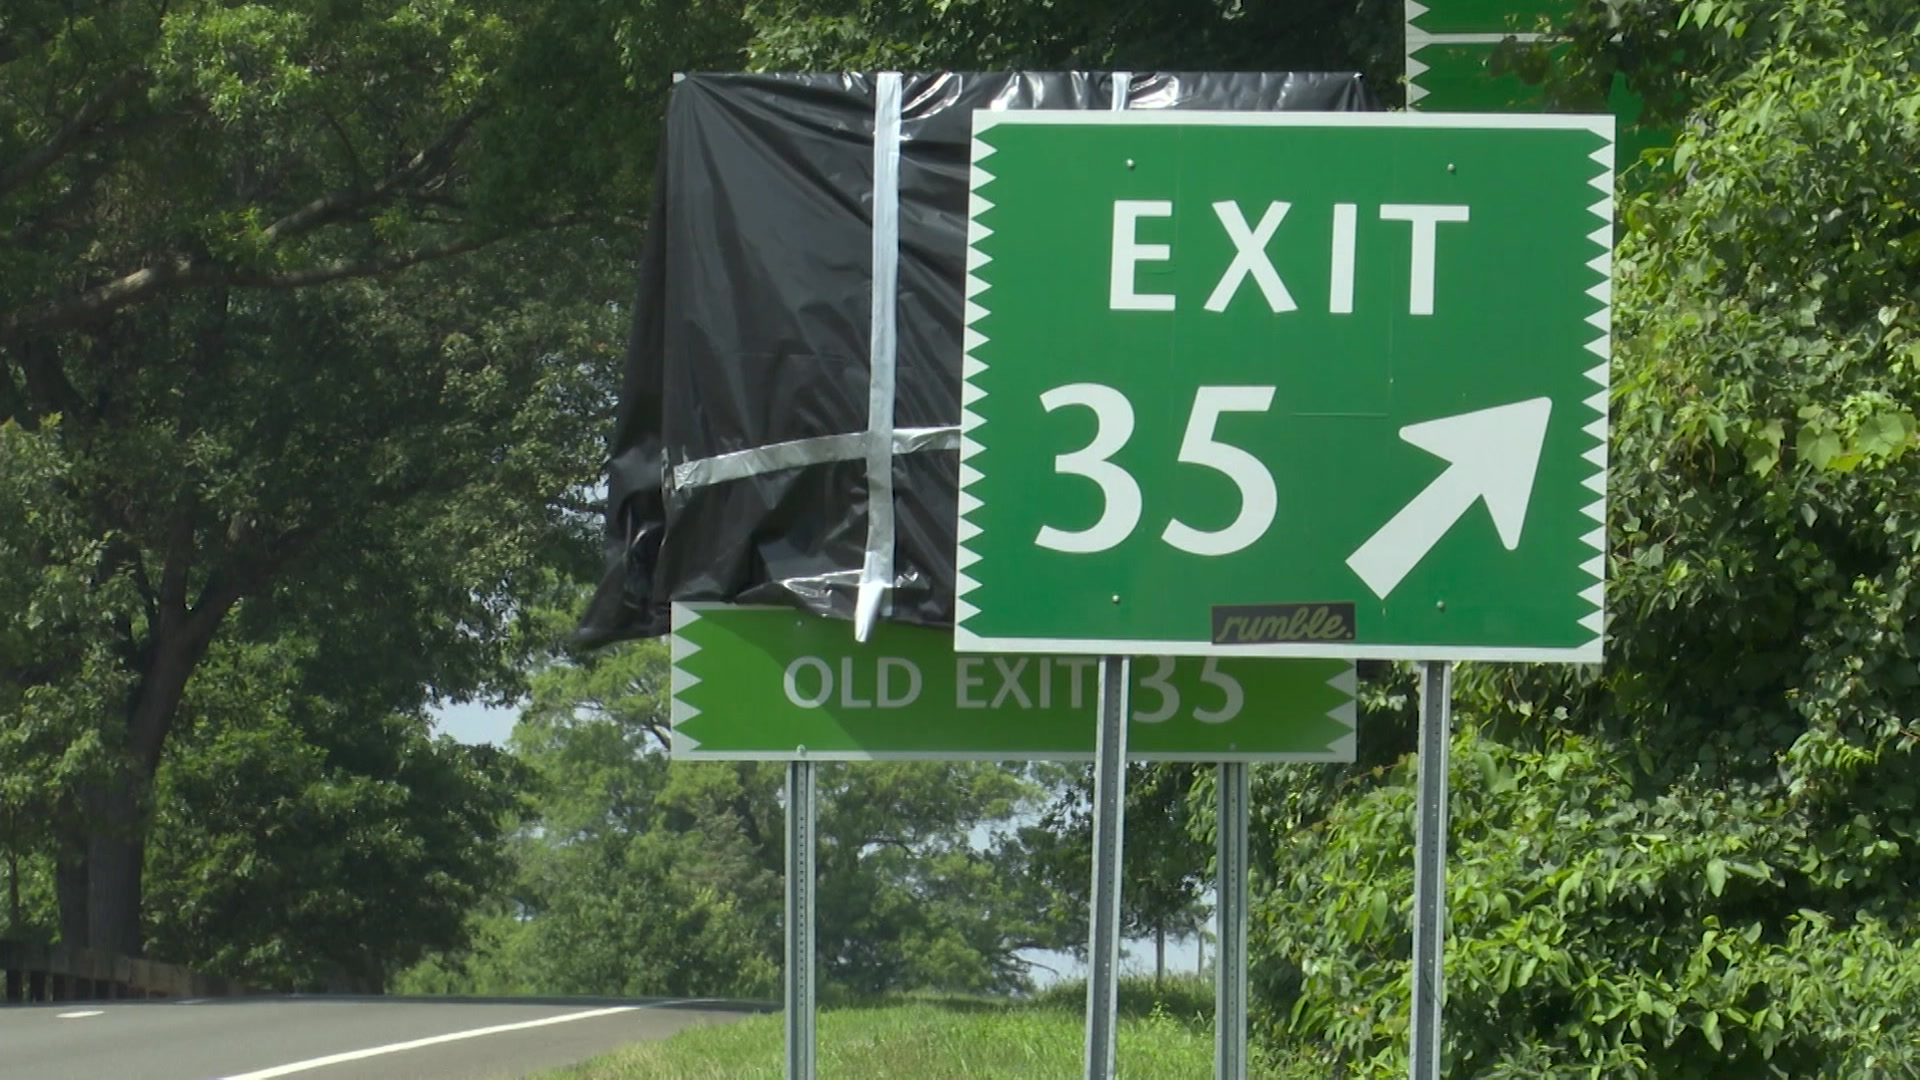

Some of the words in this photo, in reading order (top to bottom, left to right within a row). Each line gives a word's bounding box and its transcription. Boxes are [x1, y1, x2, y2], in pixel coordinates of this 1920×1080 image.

[1108, 199, 1470, 316] EXIT
[1034, 382, 1279, 557] 35
[783, 656, 922, 710] OLD
[955, 656, 1098, 710] EXIT
[1131, 656, 1246, 725] 35
